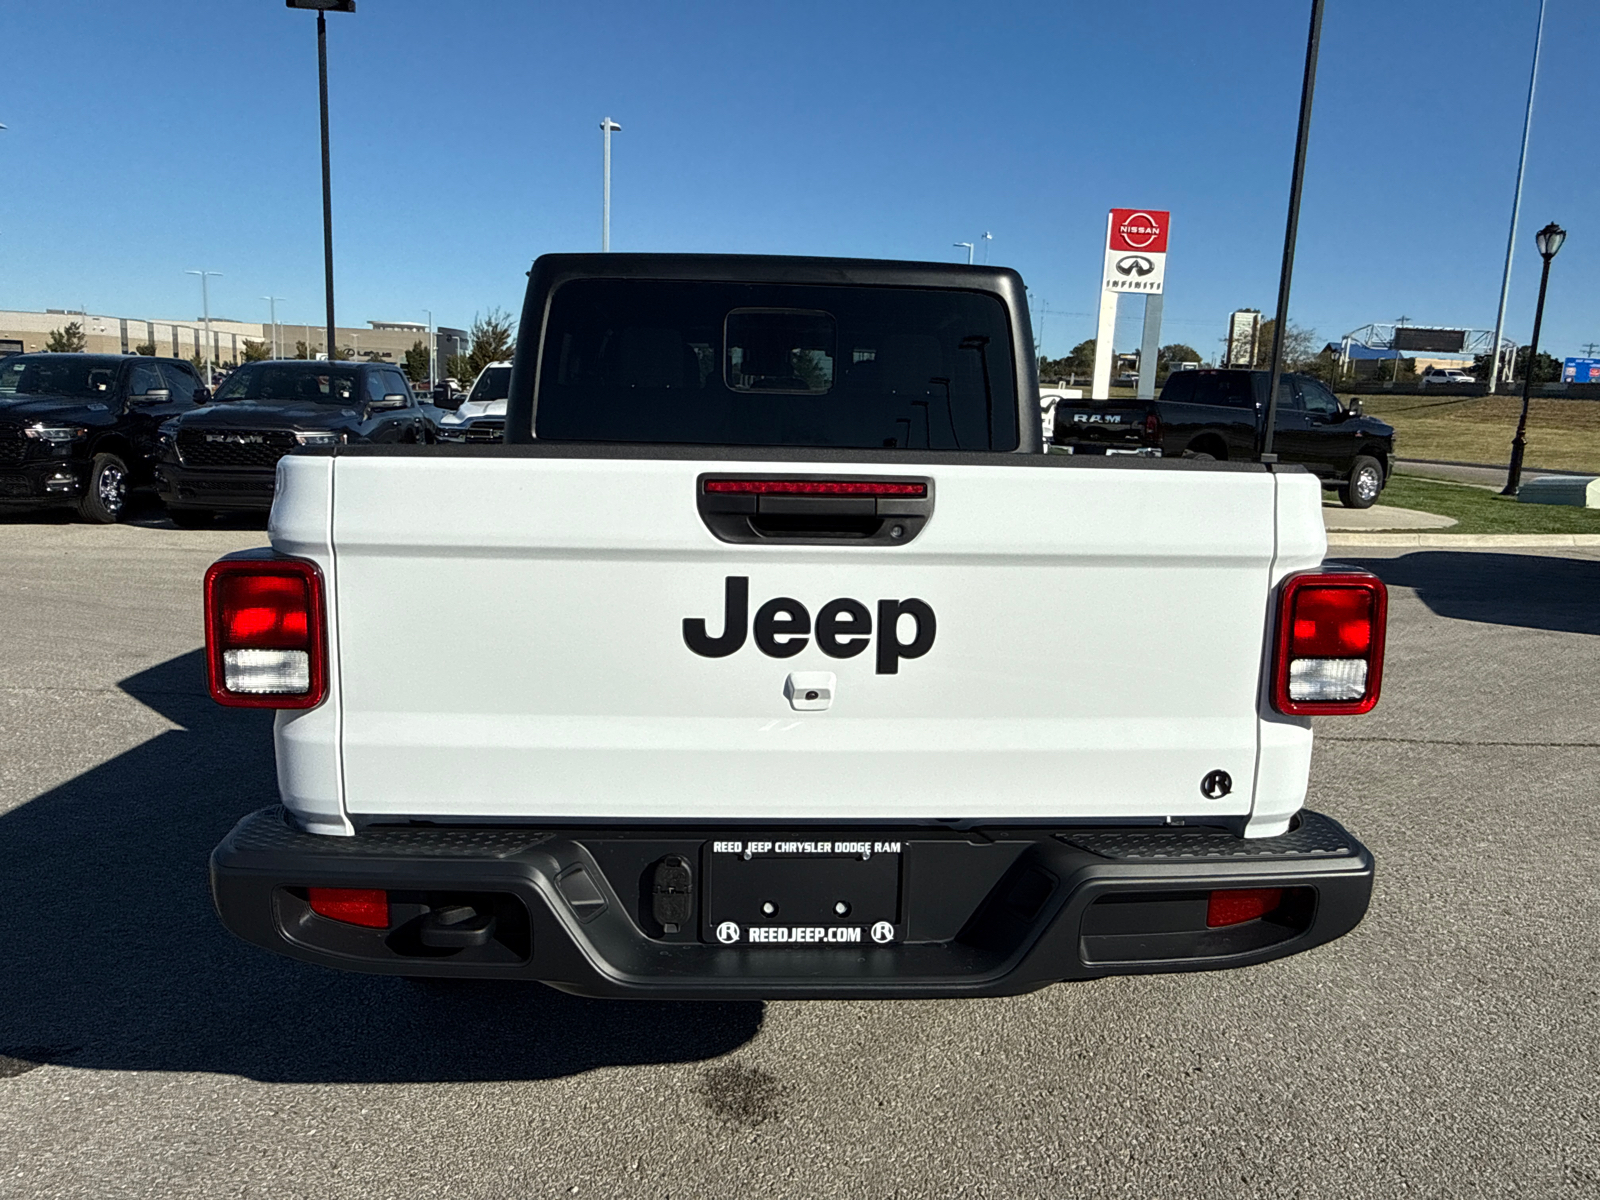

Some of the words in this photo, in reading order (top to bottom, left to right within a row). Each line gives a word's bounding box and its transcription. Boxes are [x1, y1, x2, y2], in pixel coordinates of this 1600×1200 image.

[1120, 225, 1160, 235] NISSAN
[1106, 279, 1162, 291] INFINITI
[1073, 413, 1122, 424] RAM
[205, 434, 264, 444] RAM
[682, 576, 937, 675] Jeep
[713, 841, 742, 853] REED
[745, 841, 772, 853] JEEP
[774, 841, 832, 853] CHRYSLER
[834, 841, 871, 853] DODGE
[874, 841, 901, 853] RAM
[748, 927, 861, 942] REEDJEEP.COM
